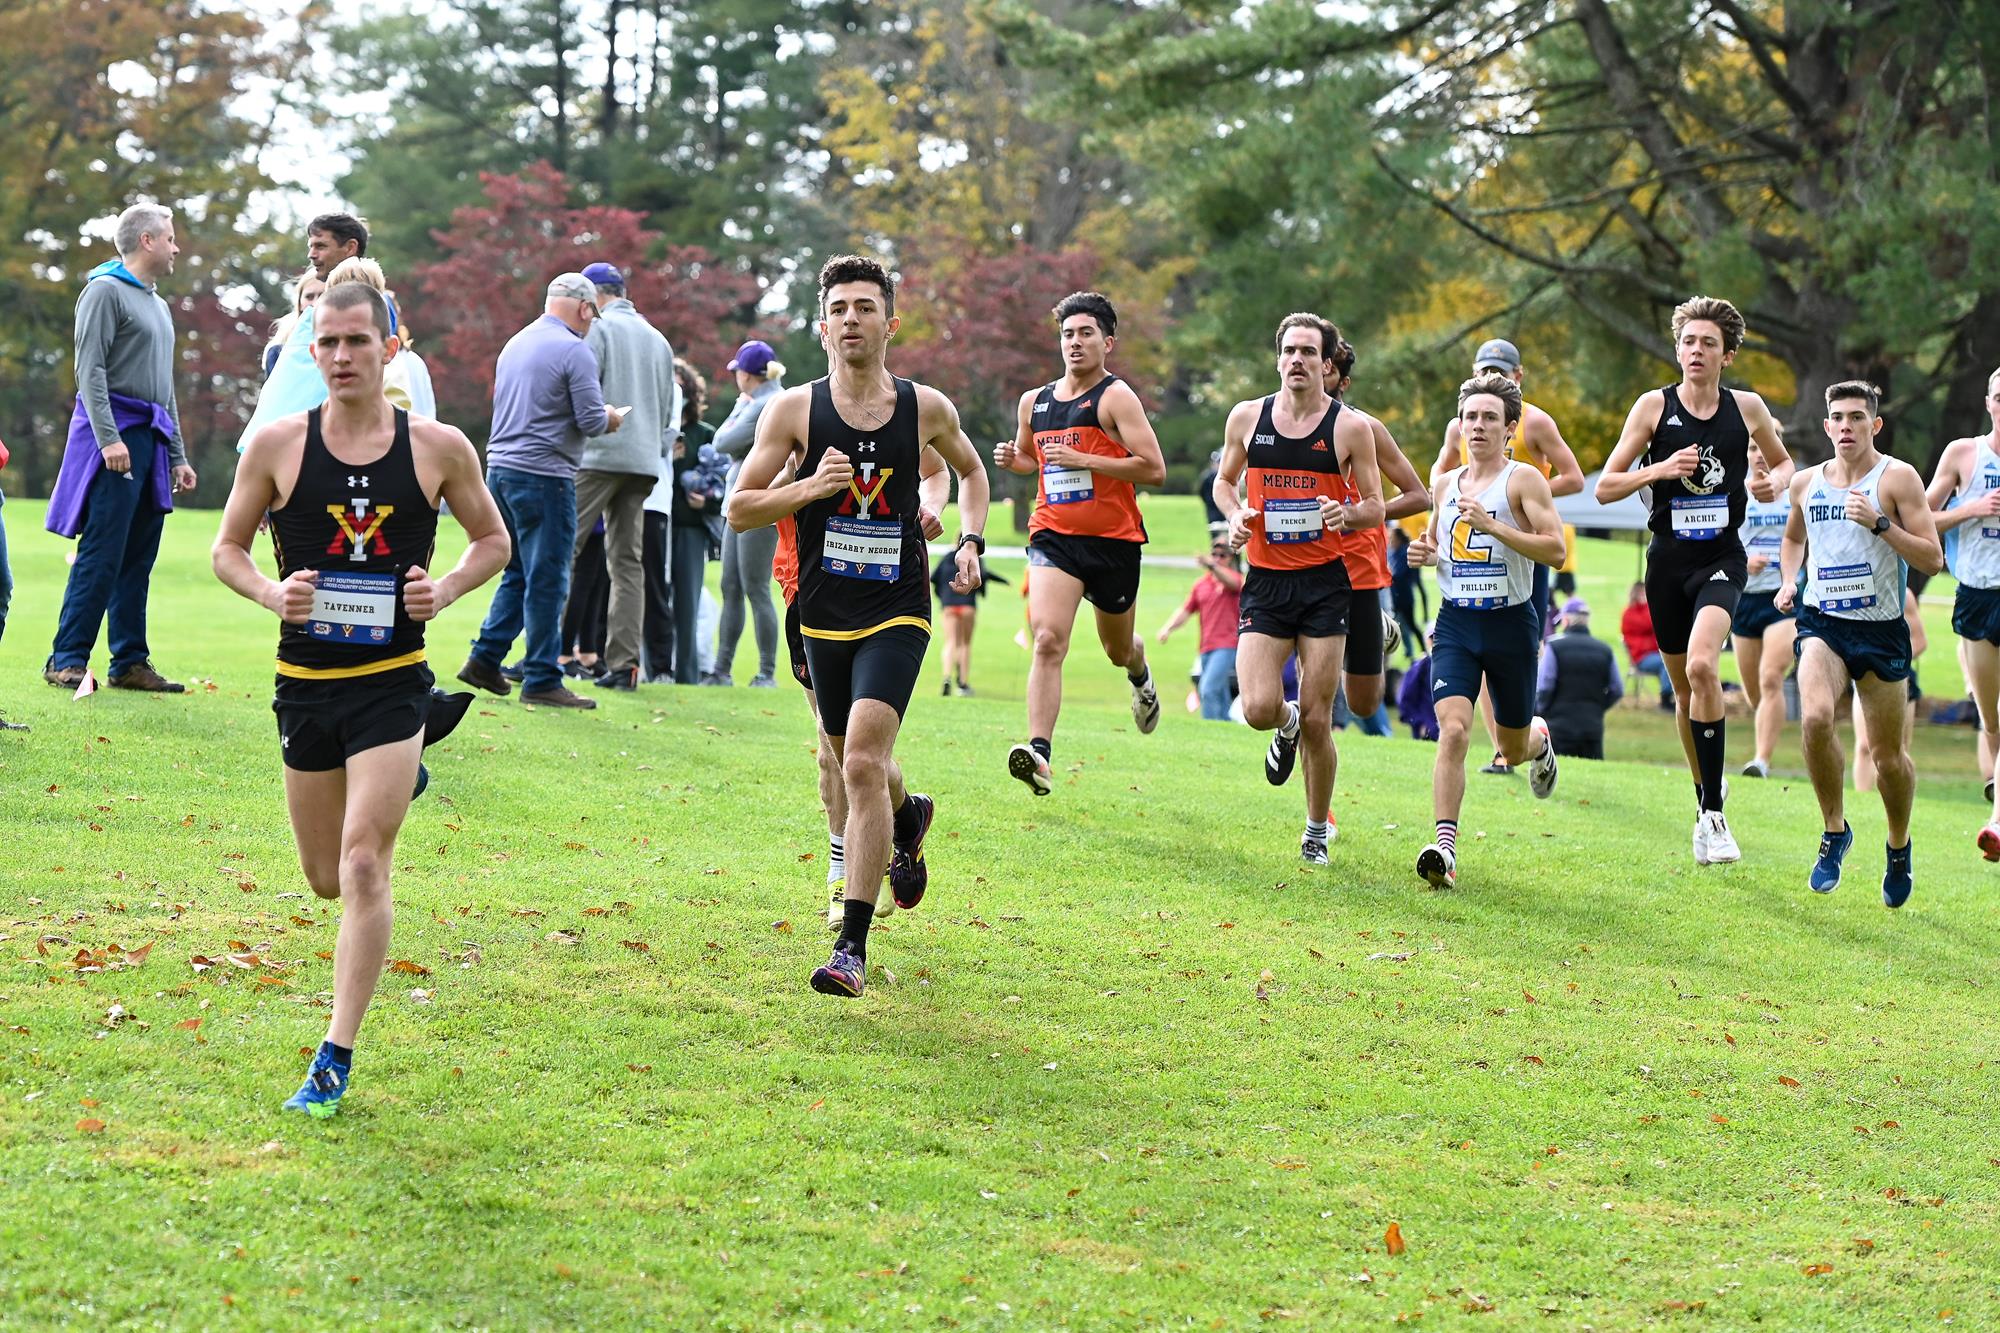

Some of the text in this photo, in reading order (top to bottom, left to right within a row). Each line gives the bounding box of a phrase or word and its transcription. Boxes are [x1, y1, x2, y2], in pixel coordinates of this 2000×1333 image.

[1685, 514, 1717, 523] ARCHIE
[1809, 505, 1829, 523] THE
[826, 541, 865, 553] IRIZARRY
[336, 577, 363, 585] SOUTHERN
[1461, 583, 1498, 591] PHILLIPS
[1826, 583, 1866, 593] PERRECONE
[324, 602, 375, 613] TAVENNER
